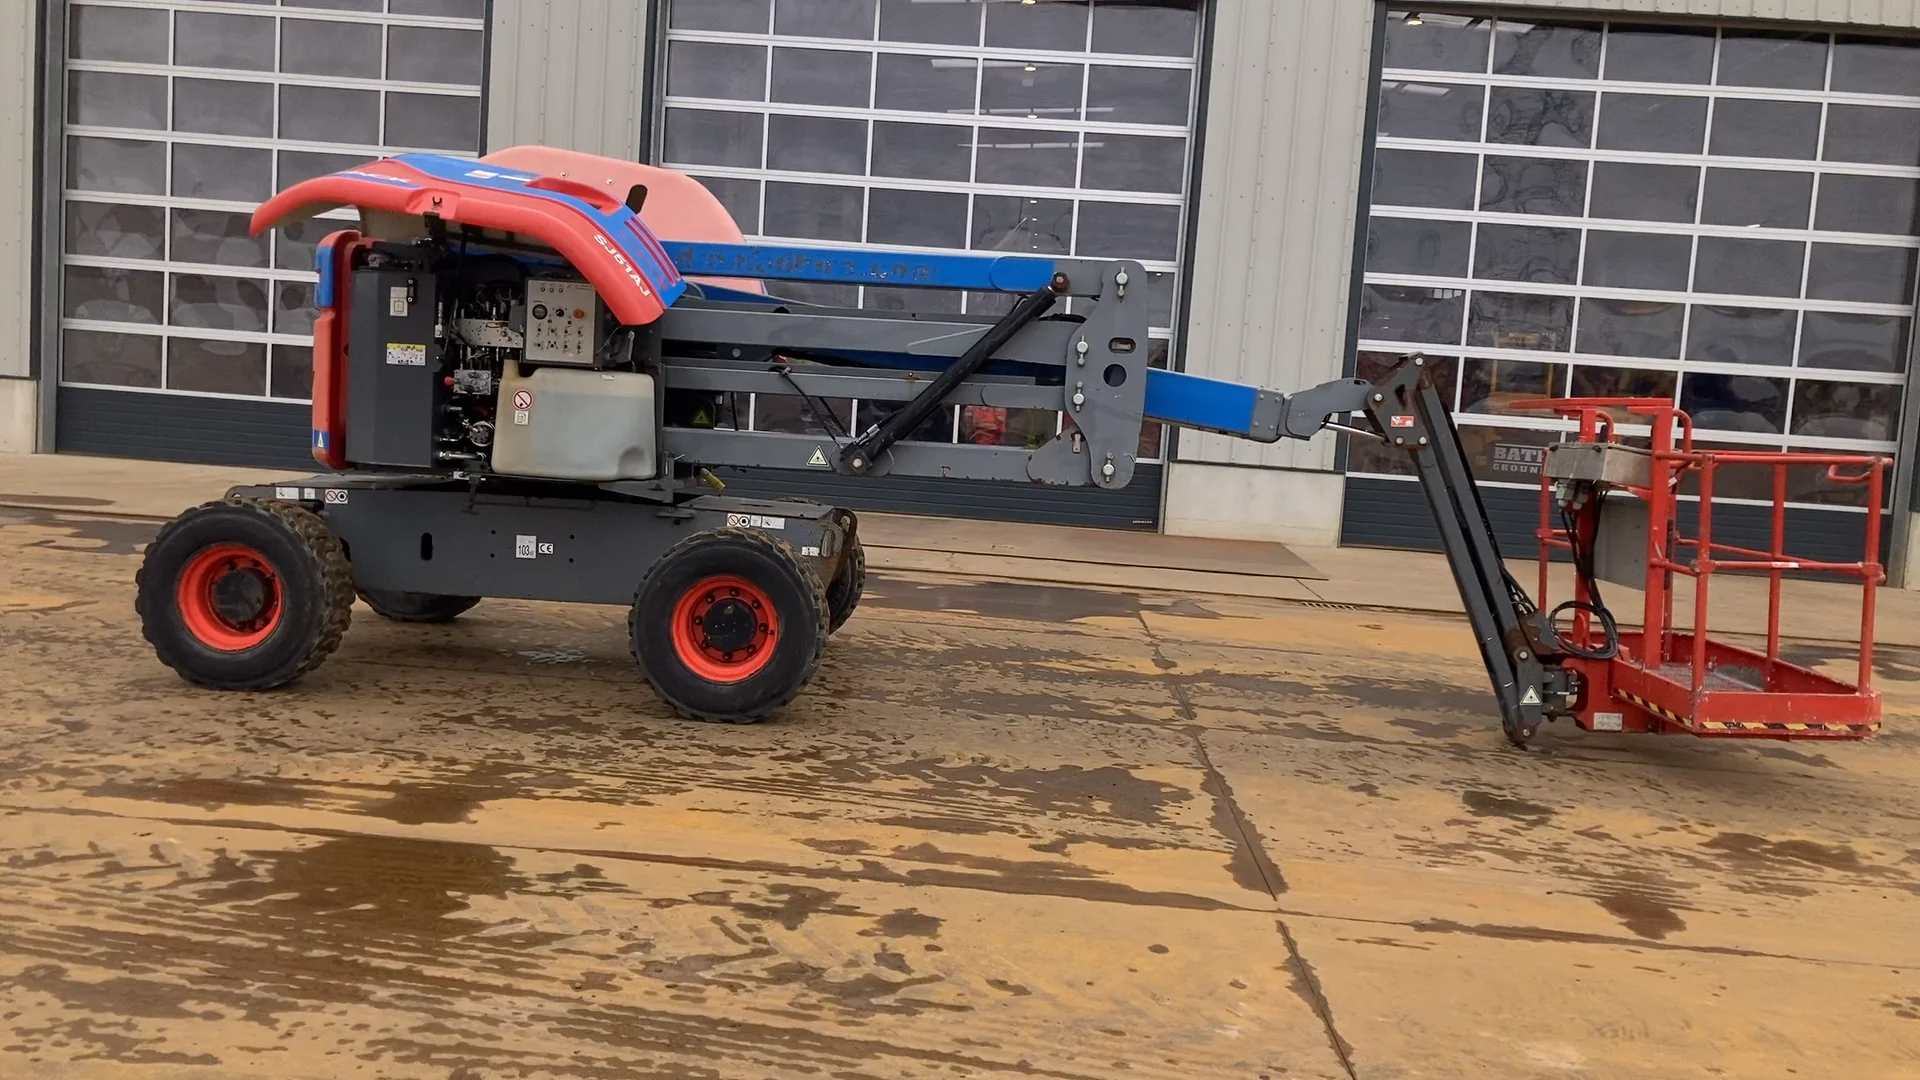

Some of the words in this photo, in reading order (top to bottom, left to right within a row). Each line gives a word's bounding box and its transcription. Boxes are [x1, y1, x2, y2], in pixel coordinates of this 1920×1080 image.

[594, 234, 651, 296] SJ51AJ
[1493, 463, 1542, 474] GROUN
[540, 544, 552, 553] CE
